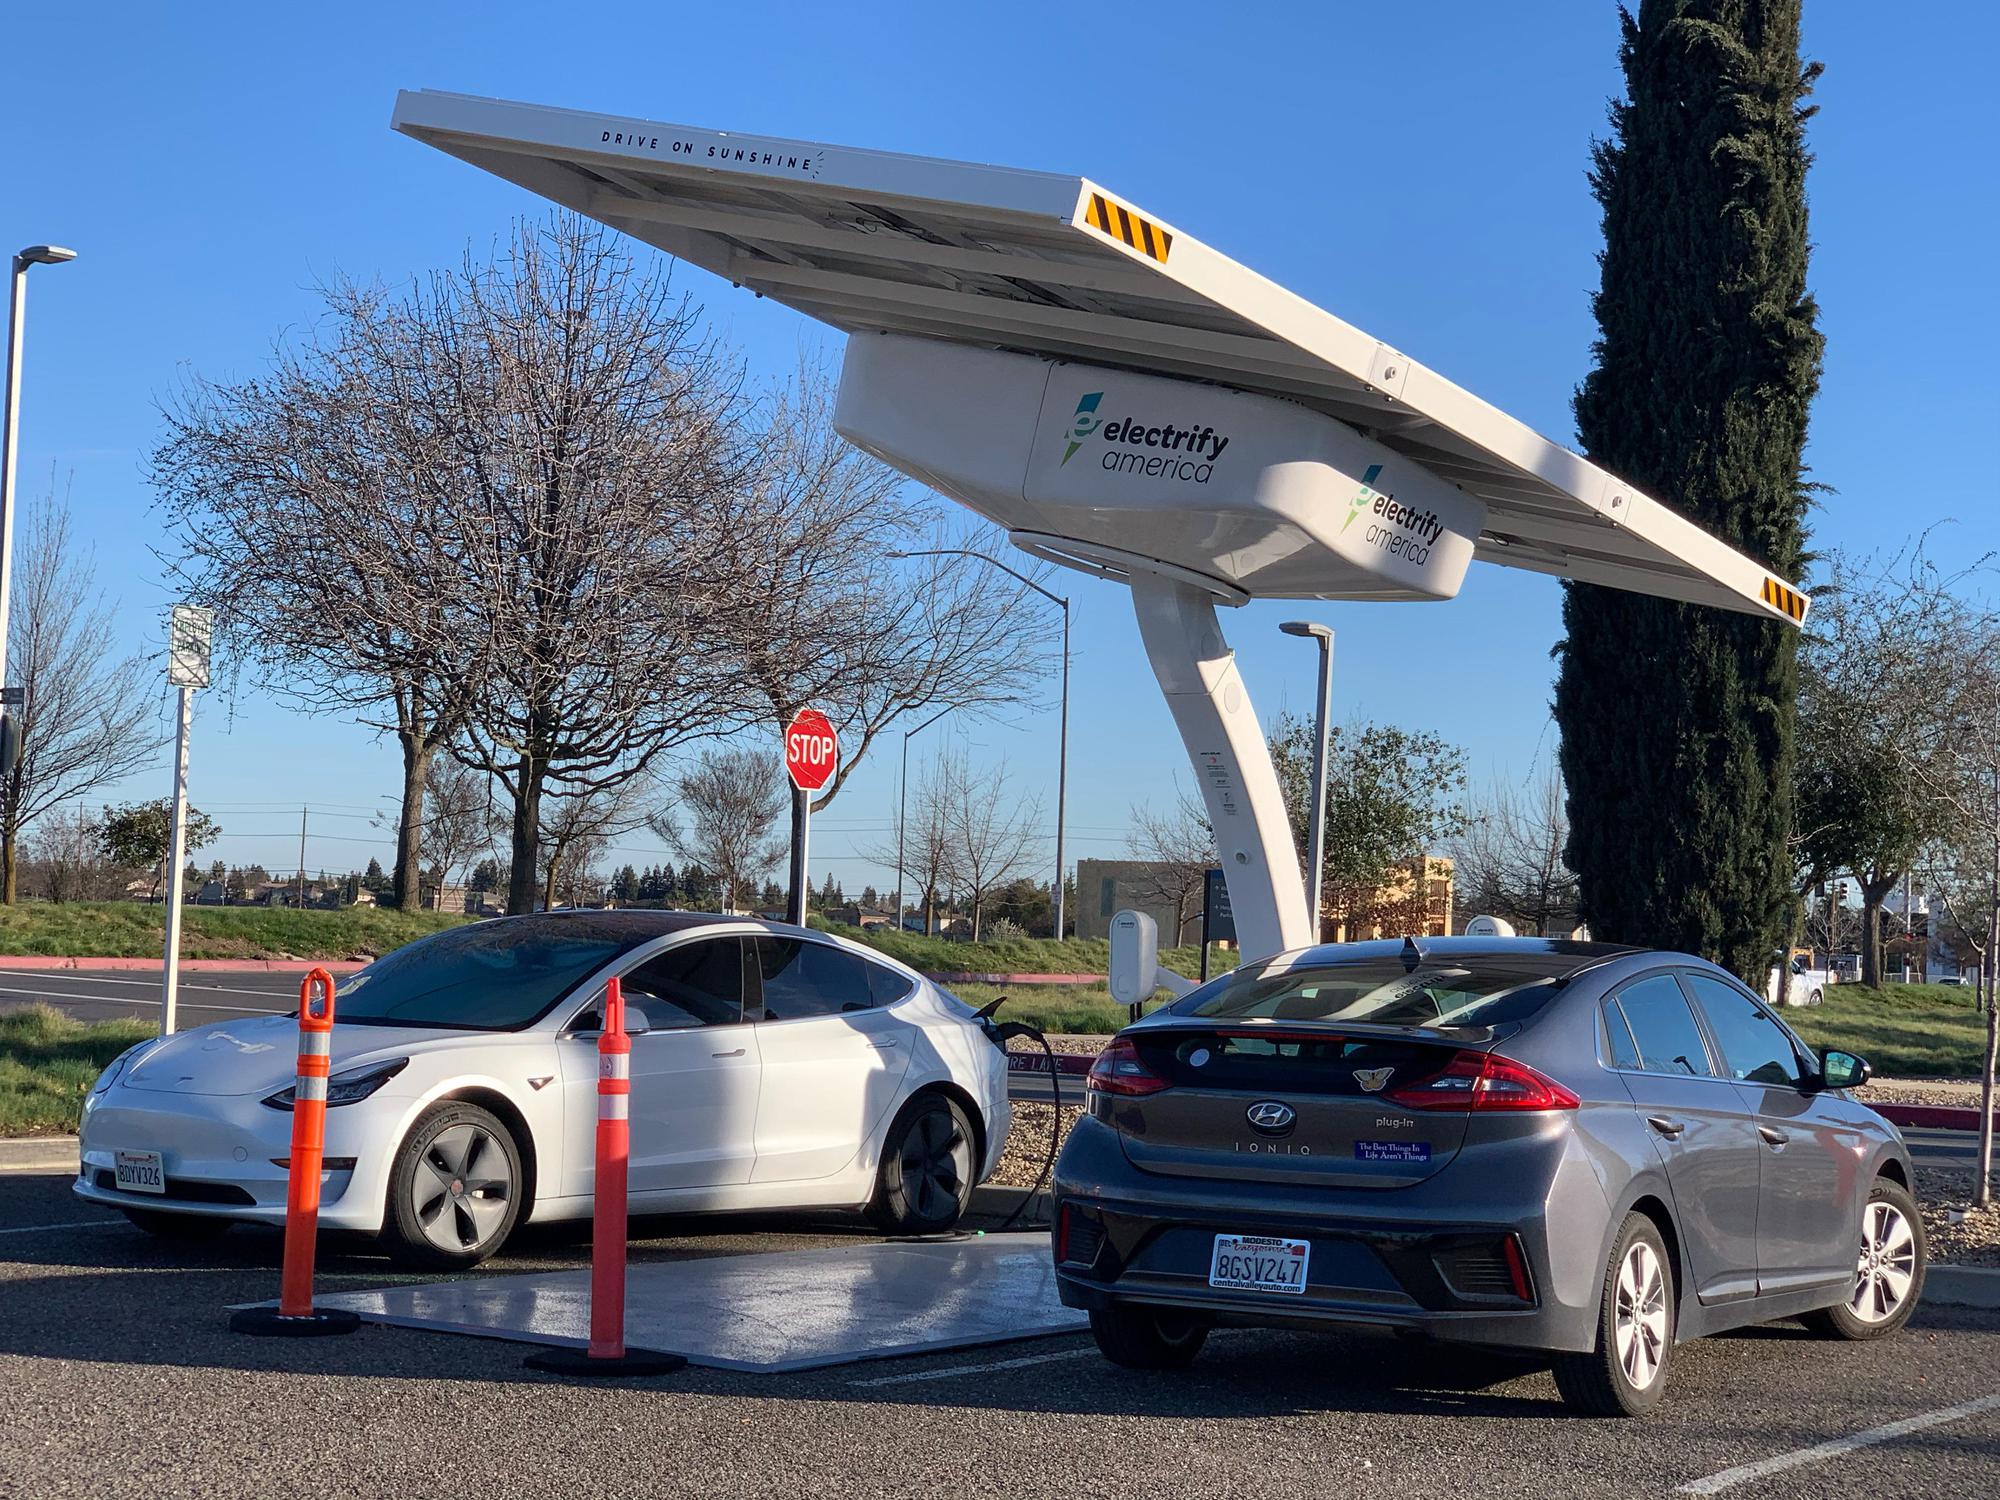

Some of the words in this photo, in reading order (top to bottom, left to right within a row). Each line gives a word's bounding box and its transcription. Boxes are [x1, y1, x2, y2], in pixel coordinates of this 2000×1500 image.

[601, 131, 658, 149] DRIVE
[672, 141, 693, 154] ON
[707, 146, 812, 171] SUNSHINE
[1103, 417, 1229, 462] electrify
[1102, 450, 1214, 484] america
[1373, 493, 1444, 546] electrify
[1366, 524, 1430, 566] america
[789, 733, 833, 766] STOP
[1376, 1116, 1414, 1129] plug-in
[1234, 1142, 1311, 1156] IONIQ
[1359, 1142, 1373, 1152] The
[1373, 1143, 1387, 1152] Best
[1388, 1143, 1411, 1153] Things
[1411, 1144, 1421, 1152] In
[1365, 1150, 1379, 1160] Life
[1380, 1151, 1403, 1160] Aren't
[1403, 1152, 1428, 1162] Things
[119, 1165, 160, 1186] 8DYV326
[1242, 1237, 1283, 1246] MODESTO
[1218, 1255, 1301, 1284] 8GSV247
[1213, 1279, 1301, 1292] centralvalleyauto.com
